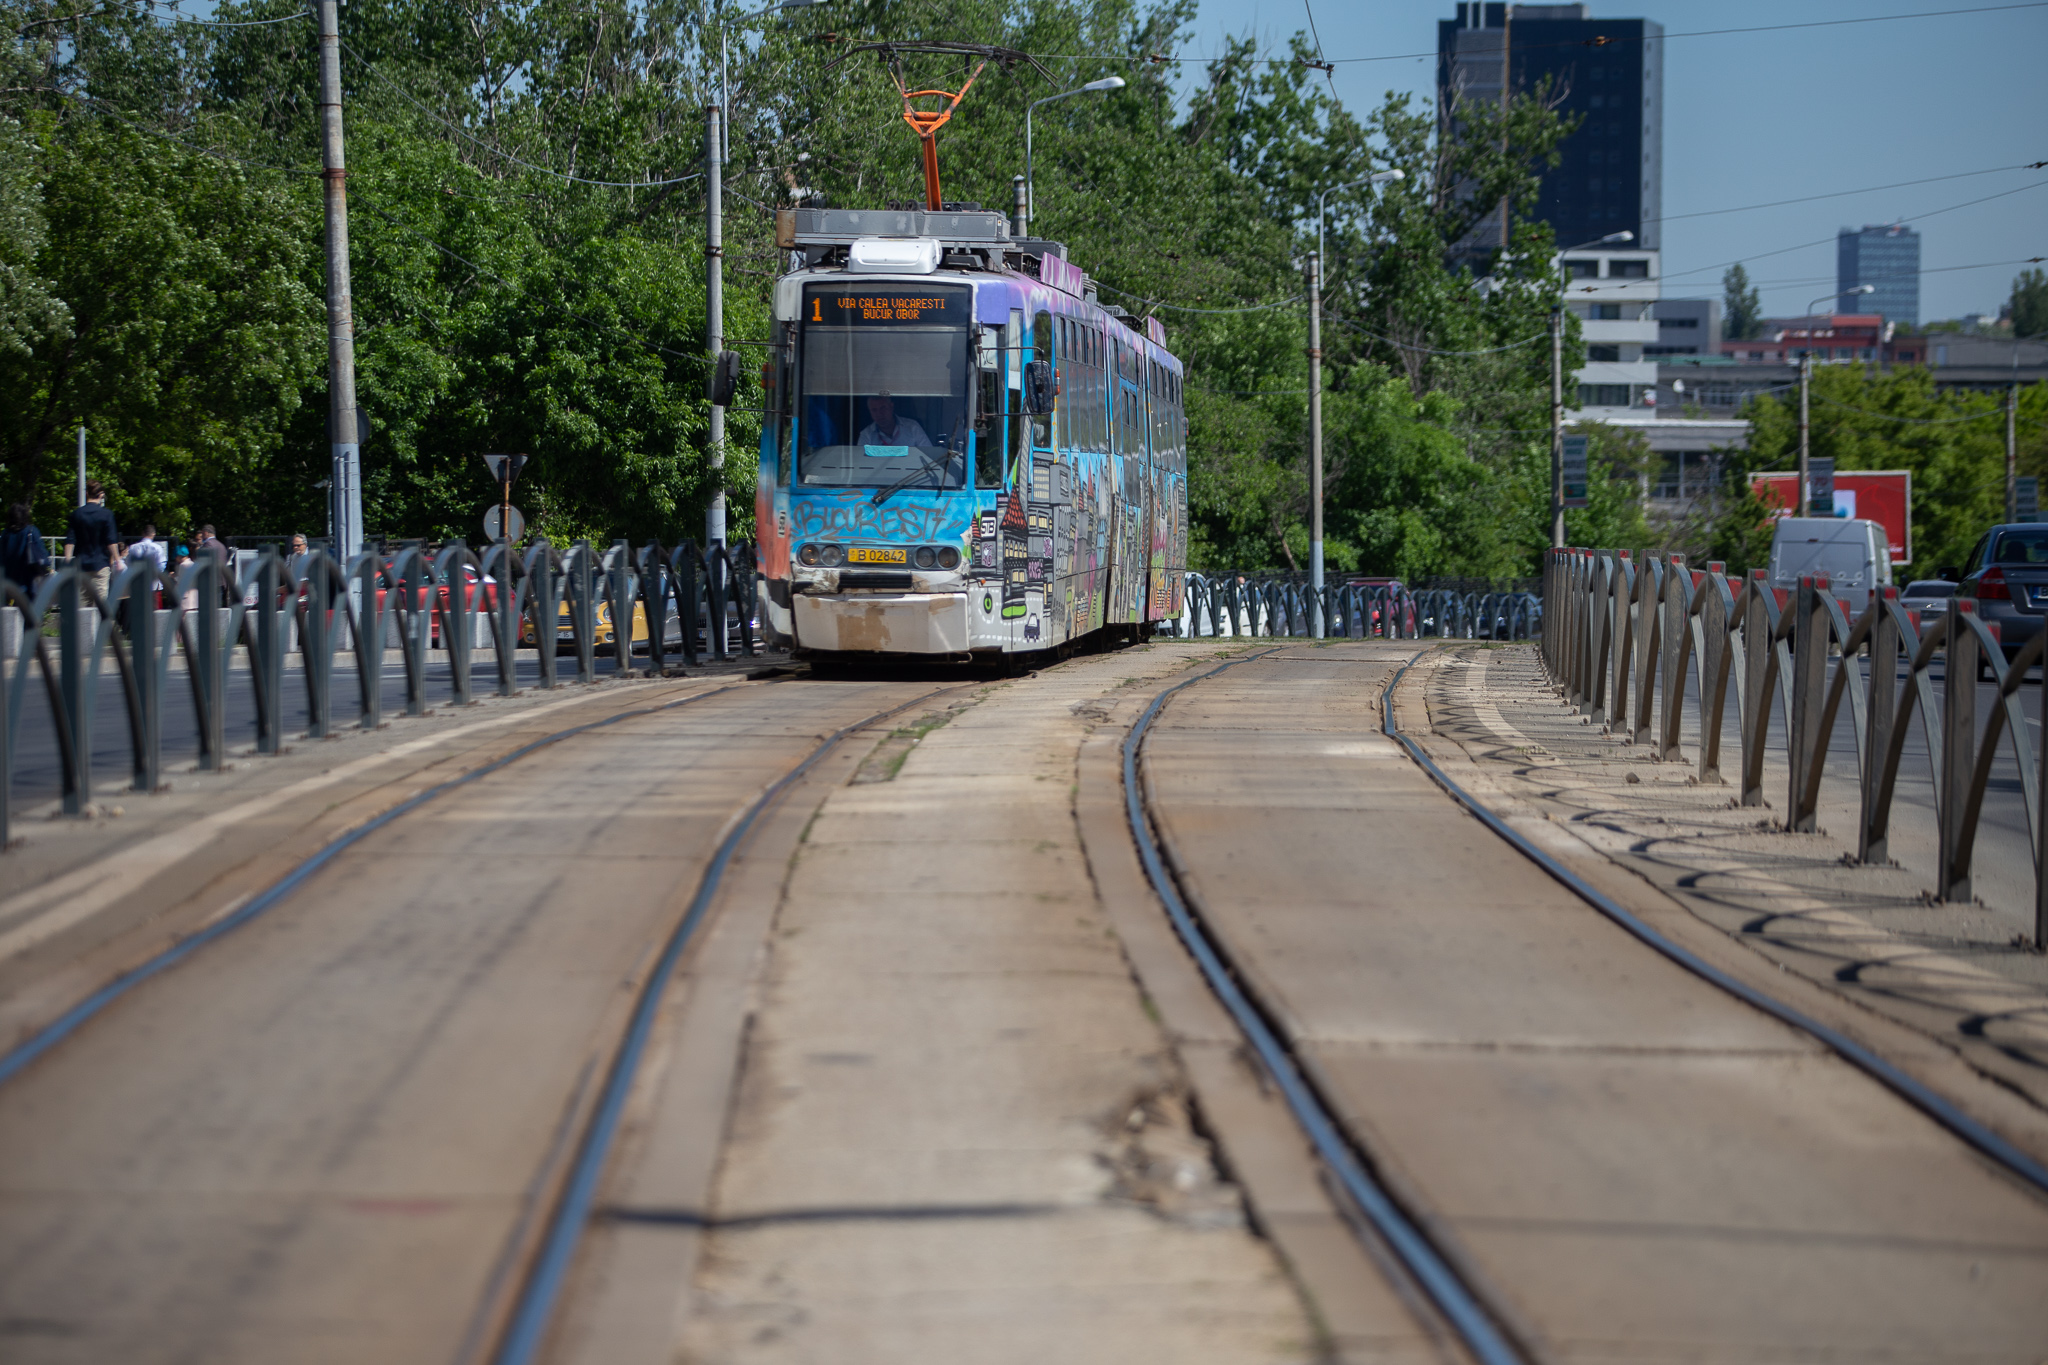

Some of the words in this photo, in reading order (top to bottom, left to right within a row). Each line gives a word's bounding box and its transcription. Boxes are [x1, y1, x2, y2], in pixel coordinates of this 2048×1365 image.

[812, 297, 822, 321] 1
[837, 298, 856, 308] VIA
[858, 298, 888, 308] CALEA
[891, 298, 945, 309] VACARESTI
[863, 309, 893, 319] BUCUR
[896, 309, 920, 319] OBOR
[981, 519, 995, 534] STB
[858, 550, 866, 562] B
[869, 550, 906, 562] 02842
